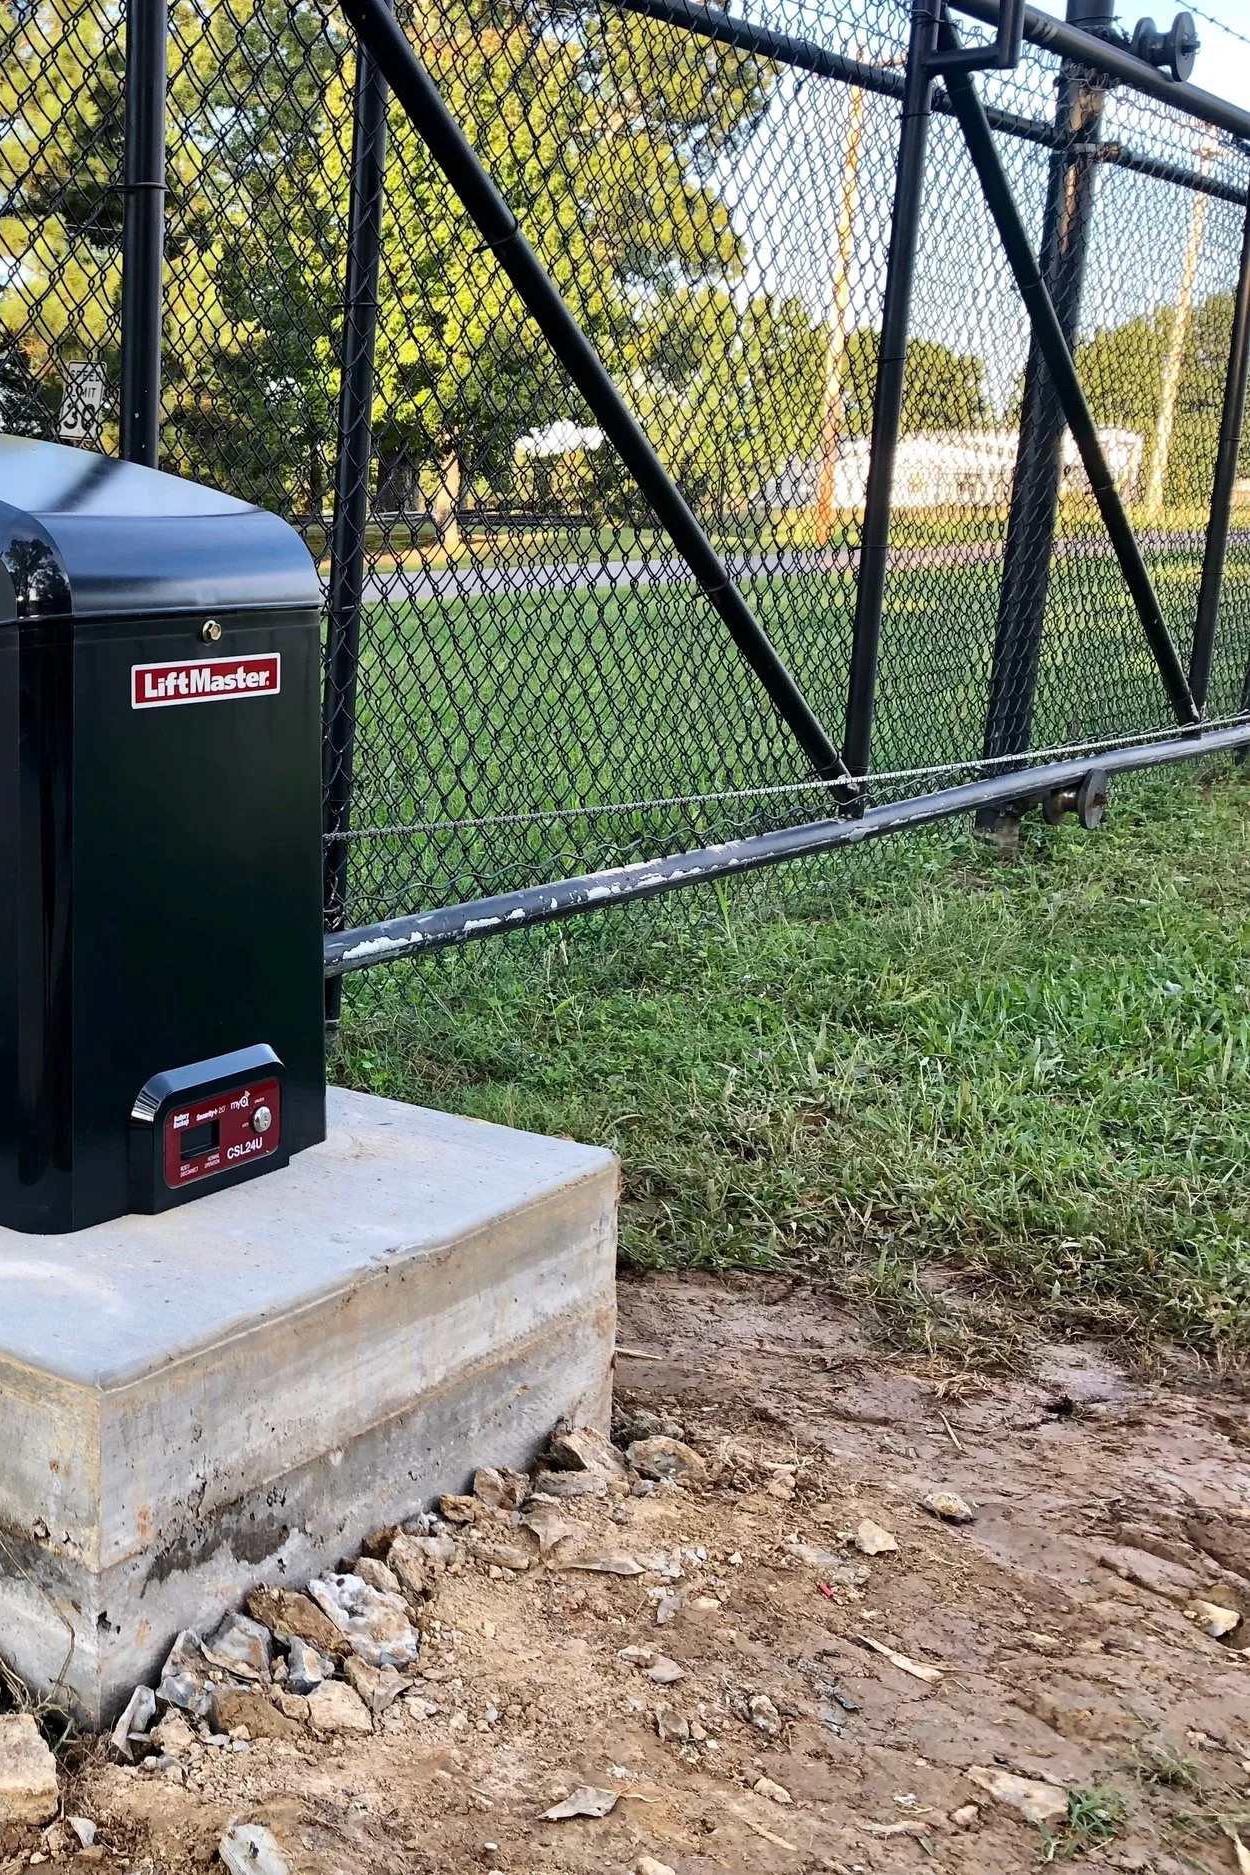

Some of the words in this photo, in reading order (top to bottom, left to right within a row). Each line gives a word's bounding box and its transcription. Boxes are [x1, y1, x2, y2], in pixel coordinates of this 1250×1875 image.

[69, 386, 97, 399] MIT
[231, 1096, 249, 1110] myQ
[226, 1137, 263, 1160] CSL24U
